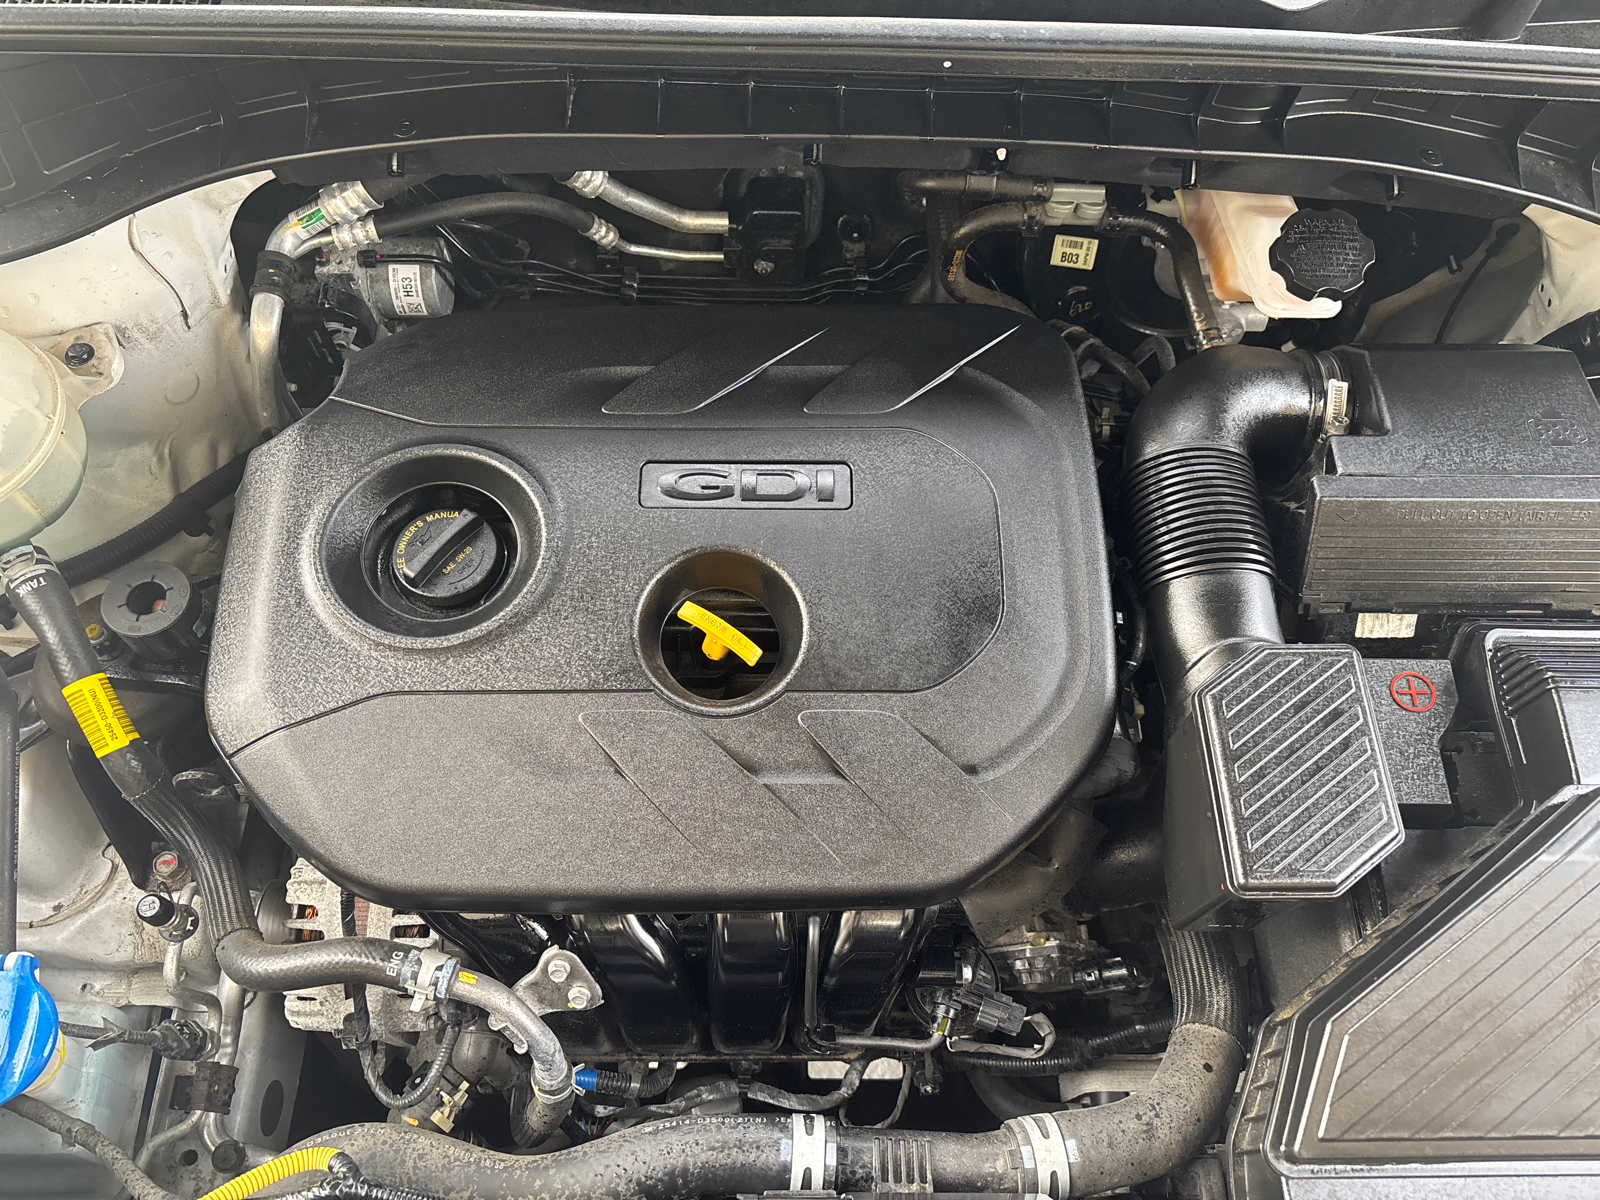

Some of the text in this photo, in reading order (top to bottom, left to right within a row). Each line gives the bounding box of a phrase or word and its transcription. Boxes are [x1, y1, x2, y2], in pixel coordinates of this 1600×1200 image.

[1060, 251, 1080, 265] B03
[401, 276, 415, 298] H53
[657, 468, 835, 502] GDI
[396, 510, 460, 574] EE OWNER'S MANUA
[442, 561, 457, 575] SAE
[15, 576, 48, 598] TANK
[698, 612, 743, 647] ENGINE OIL
[87, 688, 119, 742] 25450-D3200(NU)
[385, 950, 405, 977] ENG
[658, 1116, 767, 1130] 25414-D3500(2)(N)
